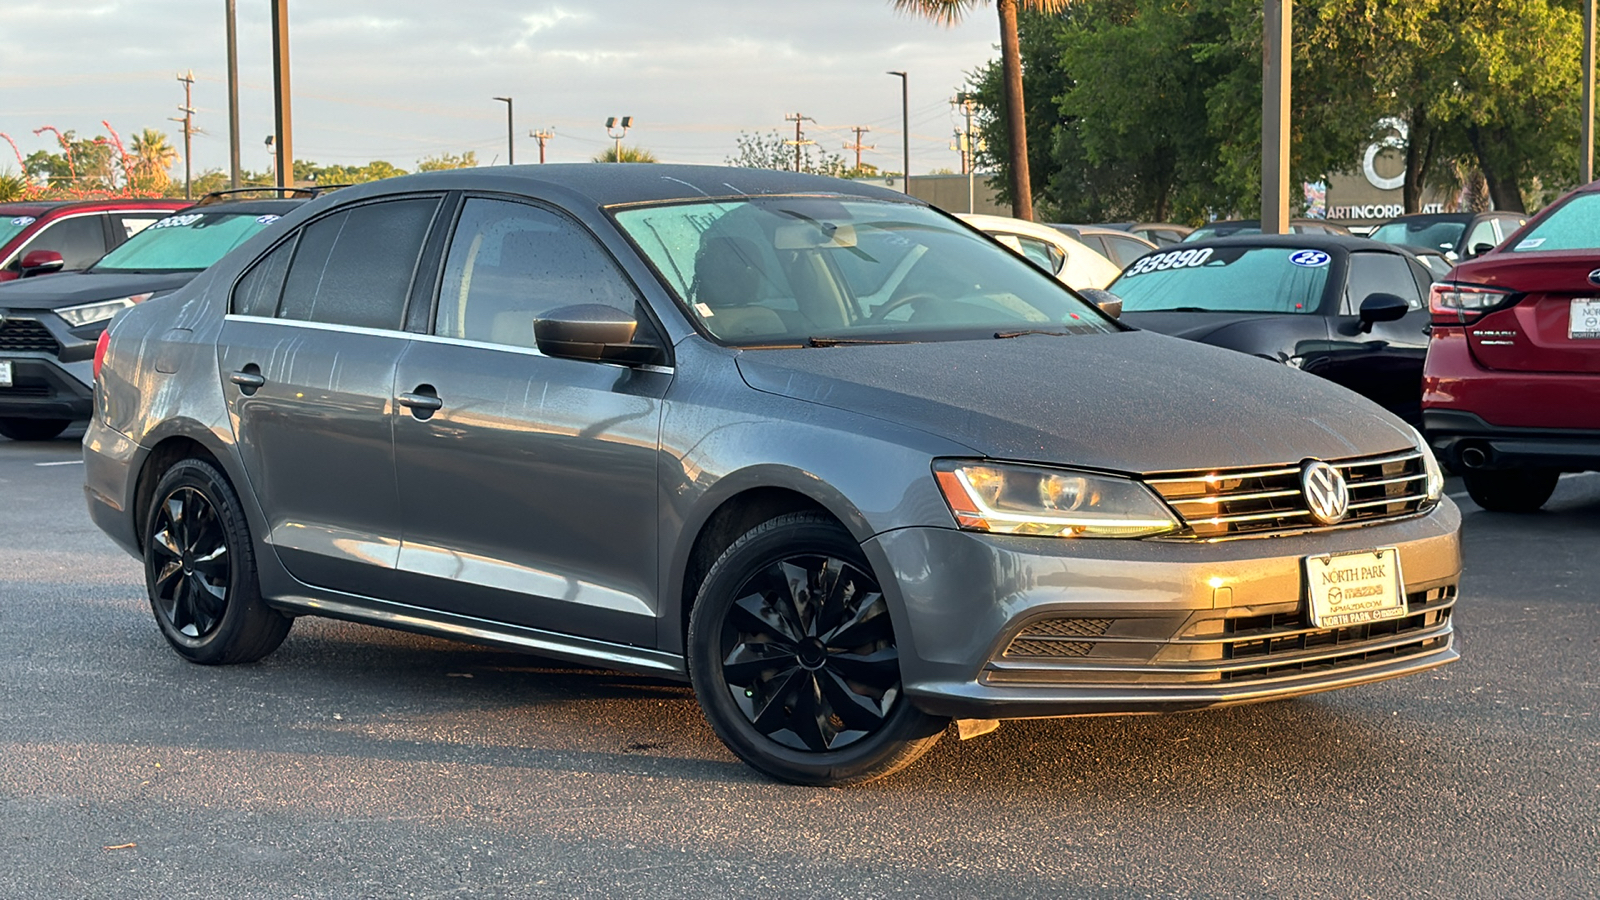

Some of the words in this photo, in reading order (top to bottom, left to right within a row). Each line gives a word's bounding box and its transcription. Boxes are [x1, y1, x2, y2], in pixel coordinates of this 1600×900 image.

[1126, 247, 1214, 279] 33990
[1295, 251, 1326, 266] 25
[1322, 568, 1359, 585] NORTH
[1361, 564, 1386, 580] PARK
[1323, 615, 1348, 627] NORTH
[1349, 612, 1372, 623] PARK
